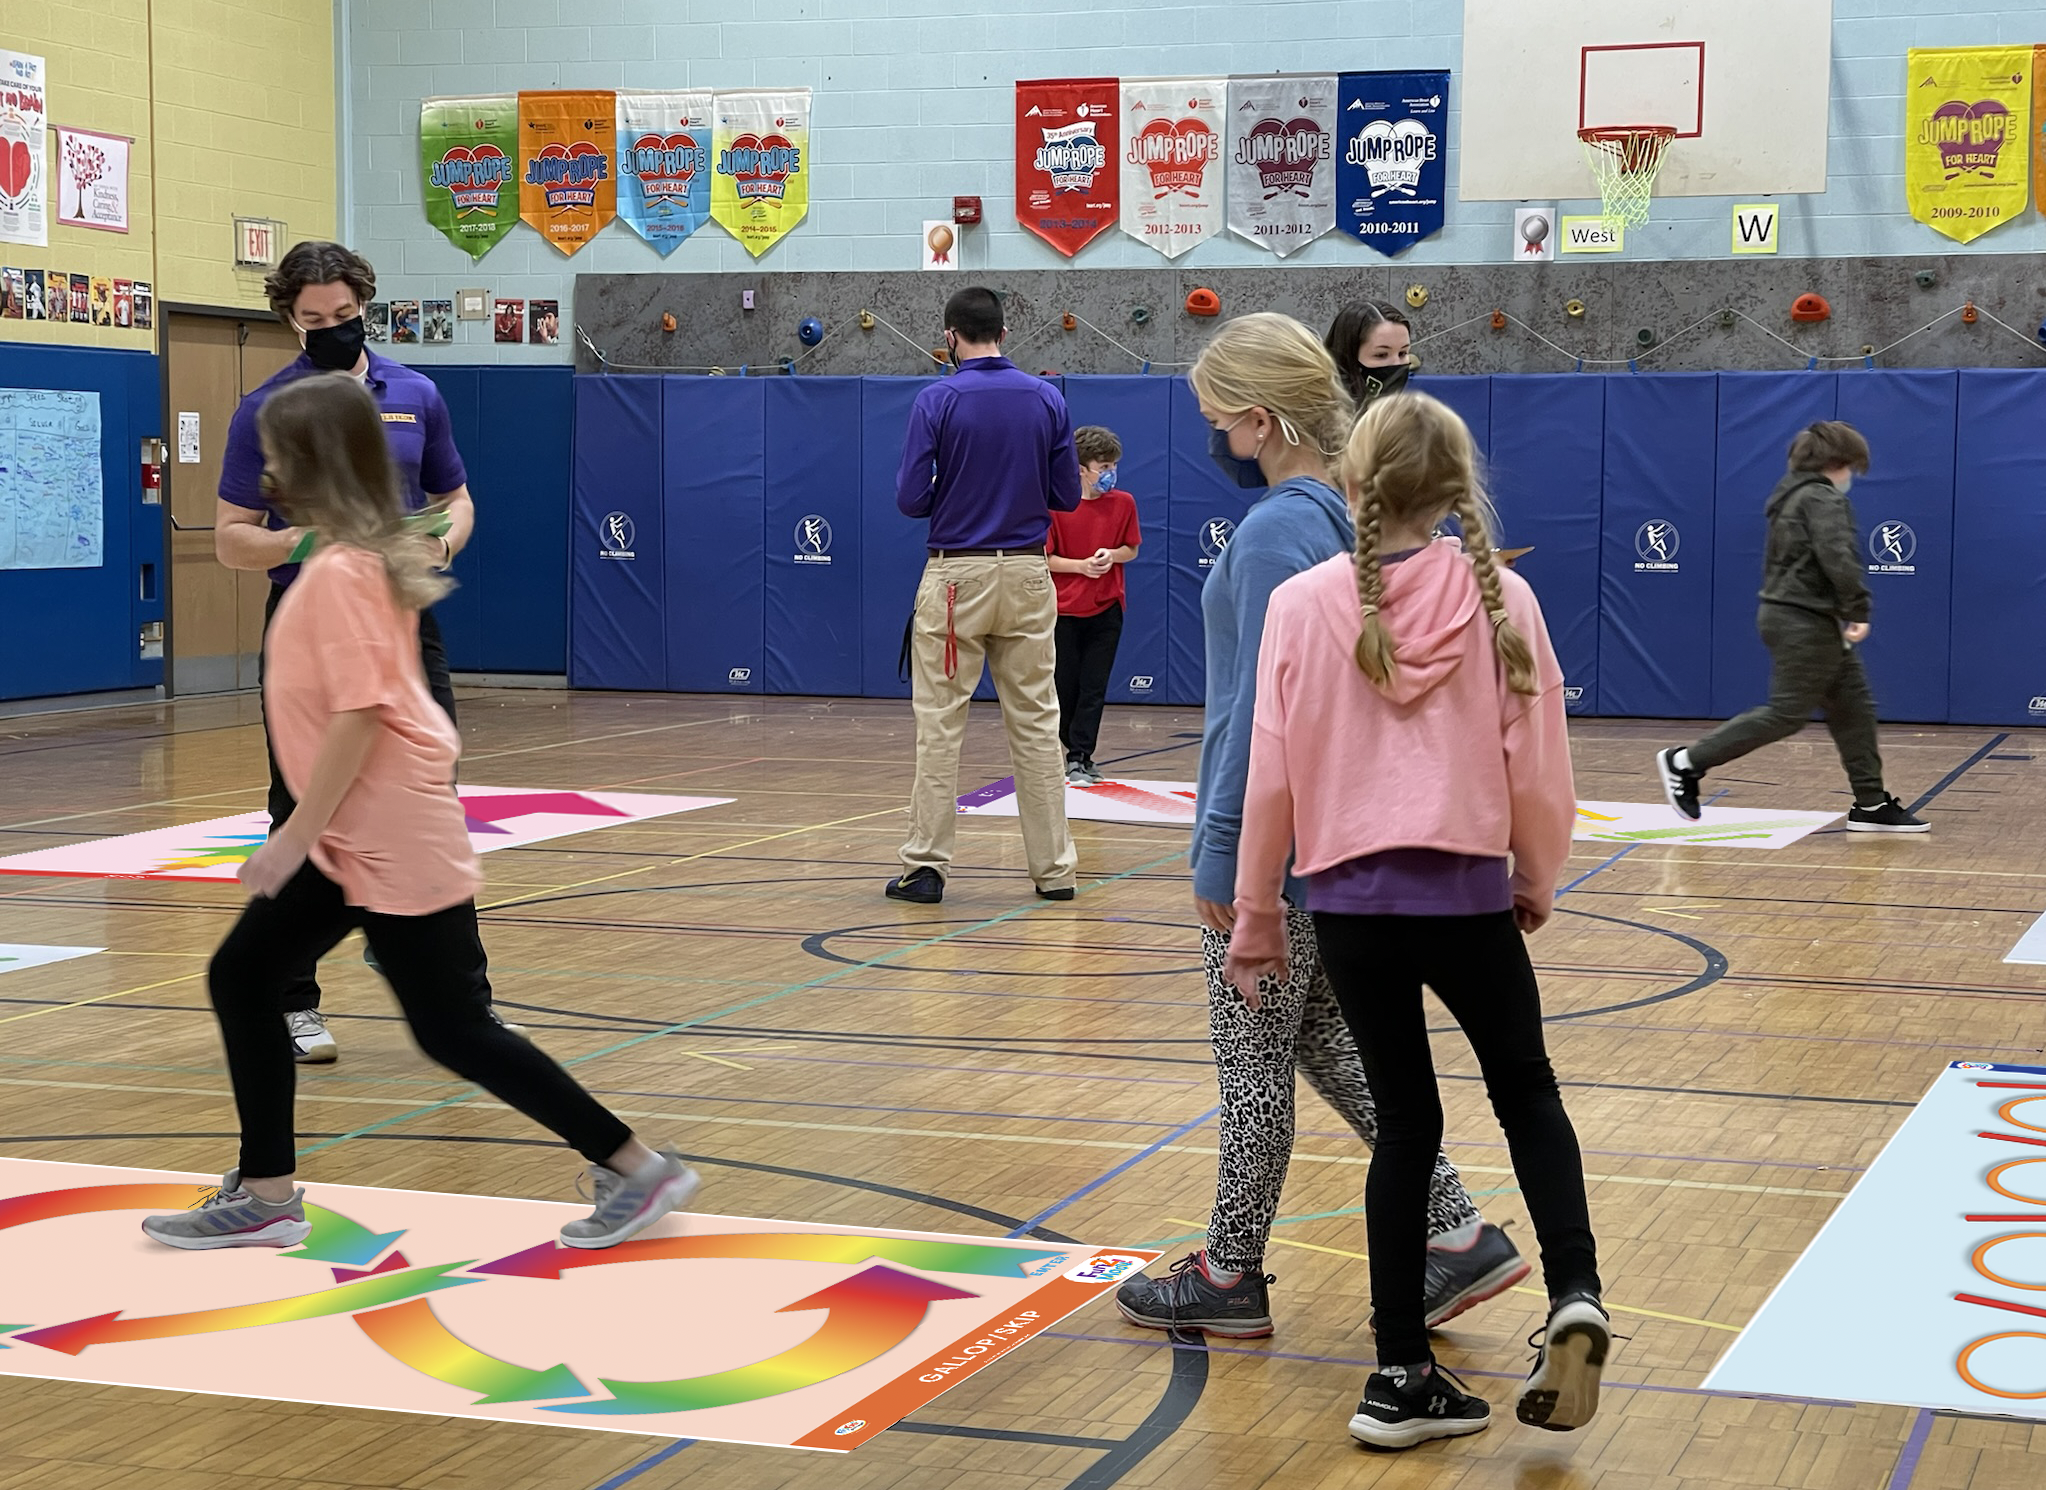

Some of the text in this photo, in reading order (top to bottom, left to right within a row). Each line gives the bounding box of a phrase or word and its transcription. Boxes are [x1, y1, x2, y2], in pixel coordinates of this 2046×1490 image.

[1059, 126, 1093, 139] Anniversary
[1918, 114, 2017, 145] JUMP ROPE
[1127, 131, 1219, 165] JUMP ROPE
[1235, 130, 1330, 165] JUMP ROPE
[1347, 134, 1436, 164] JUMP ROPE
[622, 146, 706, 175] JUMP ROPE
[717, 146, 800, 175] JUMP ROPE
[1034, 144, 1106, 170] JUMP ROPE
[1946, 153, 1996, 166] FOR HEART
[430, 157, 512, 187] JUMP ROPE
[525, 154, 608, 185] JUMP ROPE
[1055, 174, 1091, 184] FOR HEART
[1155, 172, 1200, 184] FOR HEART
[1264, 172, 1311, 184] FOR HEART
[1372, 171, 1418, 183] FOR HEART
[646, 184, 688, 193] FOR HEART
[741, 184, 782, 194] FOR HEART
[457, 194, 496, 204] FOR HEART
[550, 192, 592, 204] FOR HEART
[92, 210, 122, 222] Acceptance
[1931, 207, 2000, 218] 2009-2010
[550, 224, 589, 232] 2016-2017
[1145, 224, 1202, 234] 2012-2013
[1254, 224, 1312, 235] 2011-2012
[1359, 222, 1419, 234] 2010-2011
[1738, 214, 1774, 242] W
[1571, 228, 1616, 243] West
[249, 228, 268, 257] EXIT
[1029, 1256, 1070, 1277] ENTER
[1226, 1296, 1249, 1307] FILA
[918, 1310, 1041, 1383] GALLOP/SKIP
[1367, 1400, 1399, 1412] ARMOUR
